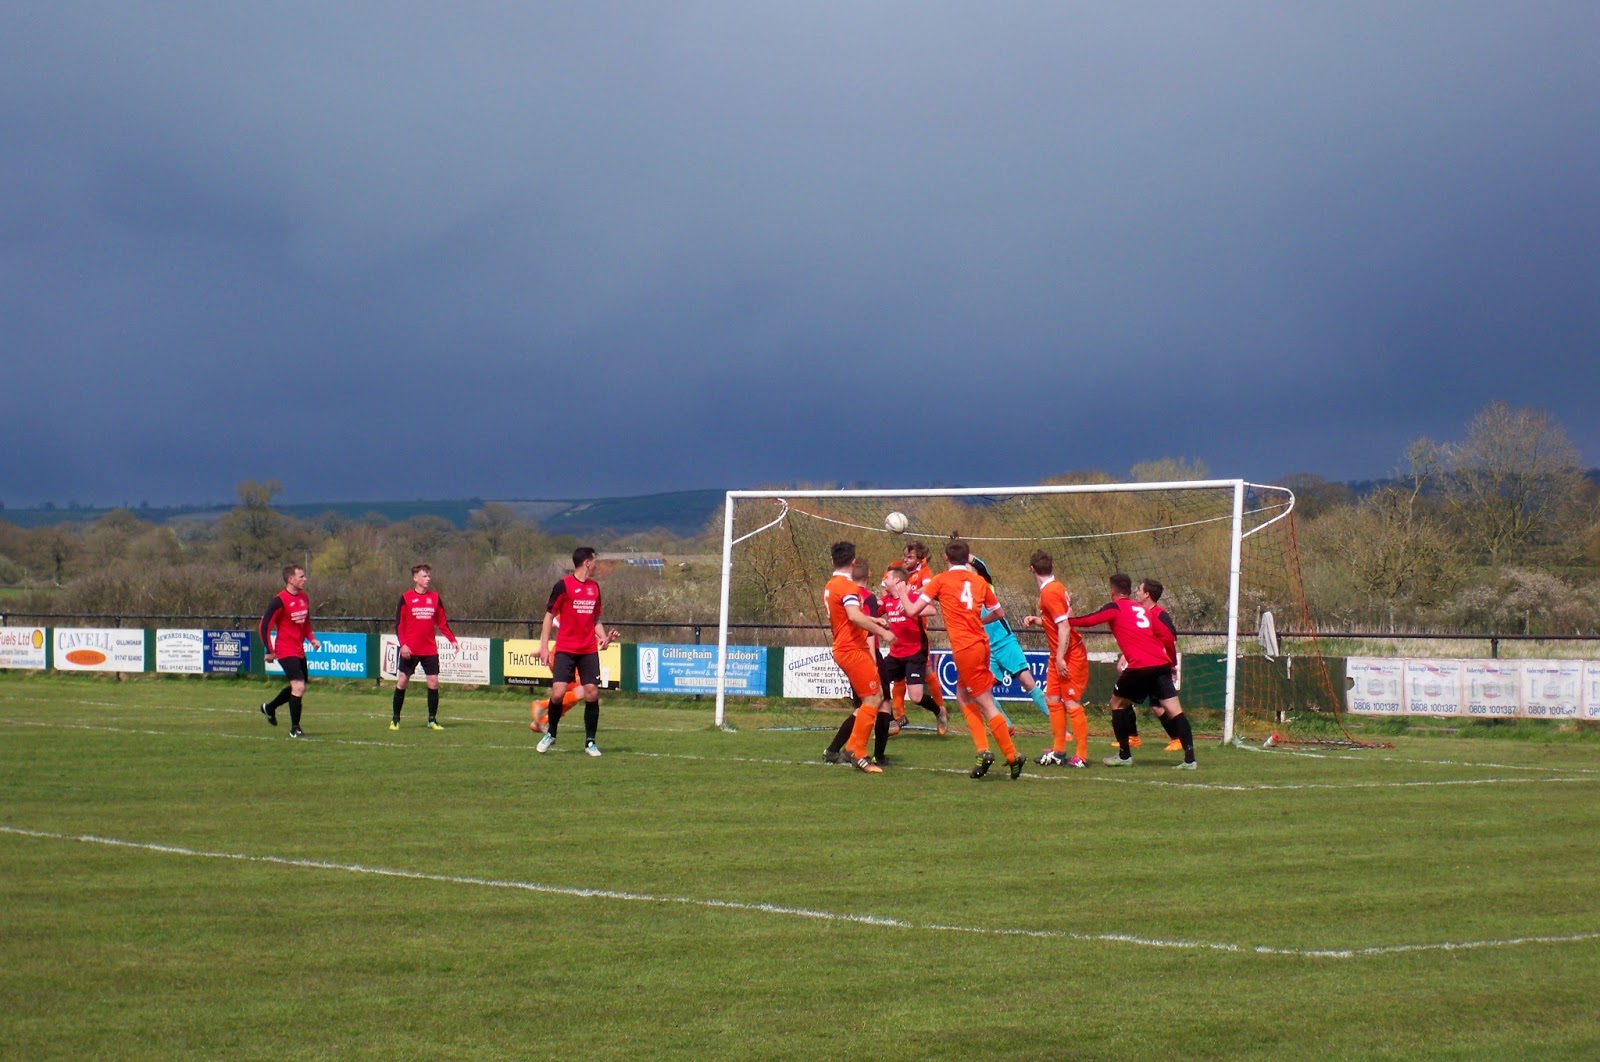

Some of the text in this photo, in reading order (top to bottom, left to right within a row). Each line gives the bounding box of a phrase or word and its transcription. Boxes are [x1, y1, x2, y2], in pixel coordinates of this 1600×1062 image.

[960, 581, 973, 610] 4
[1131, 605, 1150, 628] 3
[18, 631, 30, 646] Ltd
[57, 632, 113, 651] CAVELL
[323, 640, 357, 654] Thomas
[461, 641, 488, 651] Glass
[462, 651, 479, 661] Ltd
[662, 647, 759, 661] Gillingham ndoori
[331, 659, 365, 673] Brokers
[816, 686, 852, 696] TEL: 0174
[1353, 701, 1399, 711] 0808 1001387
[1410, 703, 1457, 713] 0808 1001387
[1469, 705, 1516, 714] 0808 1001387
[1528, 705, 1546, 714] 0808
